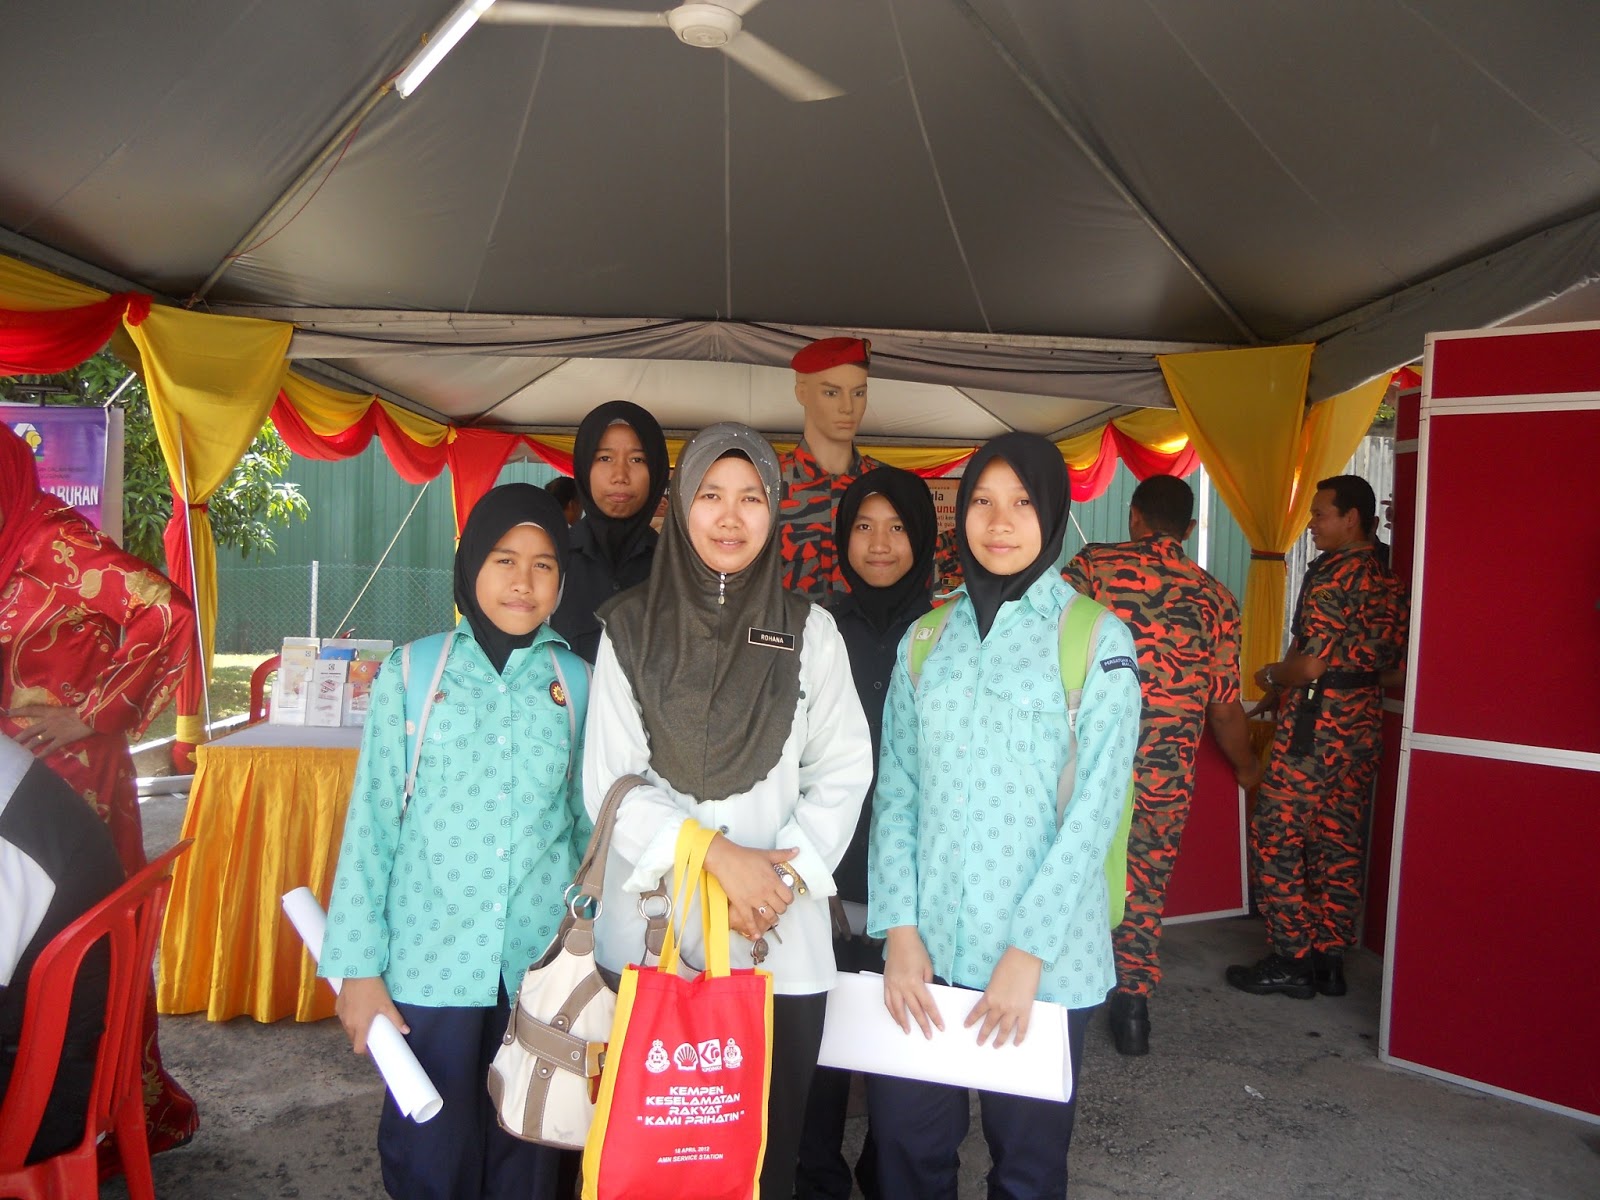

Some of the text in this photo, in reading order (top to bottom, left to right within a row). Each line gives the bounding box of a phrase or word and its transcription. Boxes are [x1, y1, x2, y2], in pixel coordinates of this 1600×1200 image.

[760, 634, 784, 643] ROHANA
[669, 1085, 724, 1096] KEMPEN
[646, 1093, 741, 1106] KESELAMATAN
[668, 1105, 722, 1116] RAKYAT
[673, 1154, 698, 1163] SERVICE
